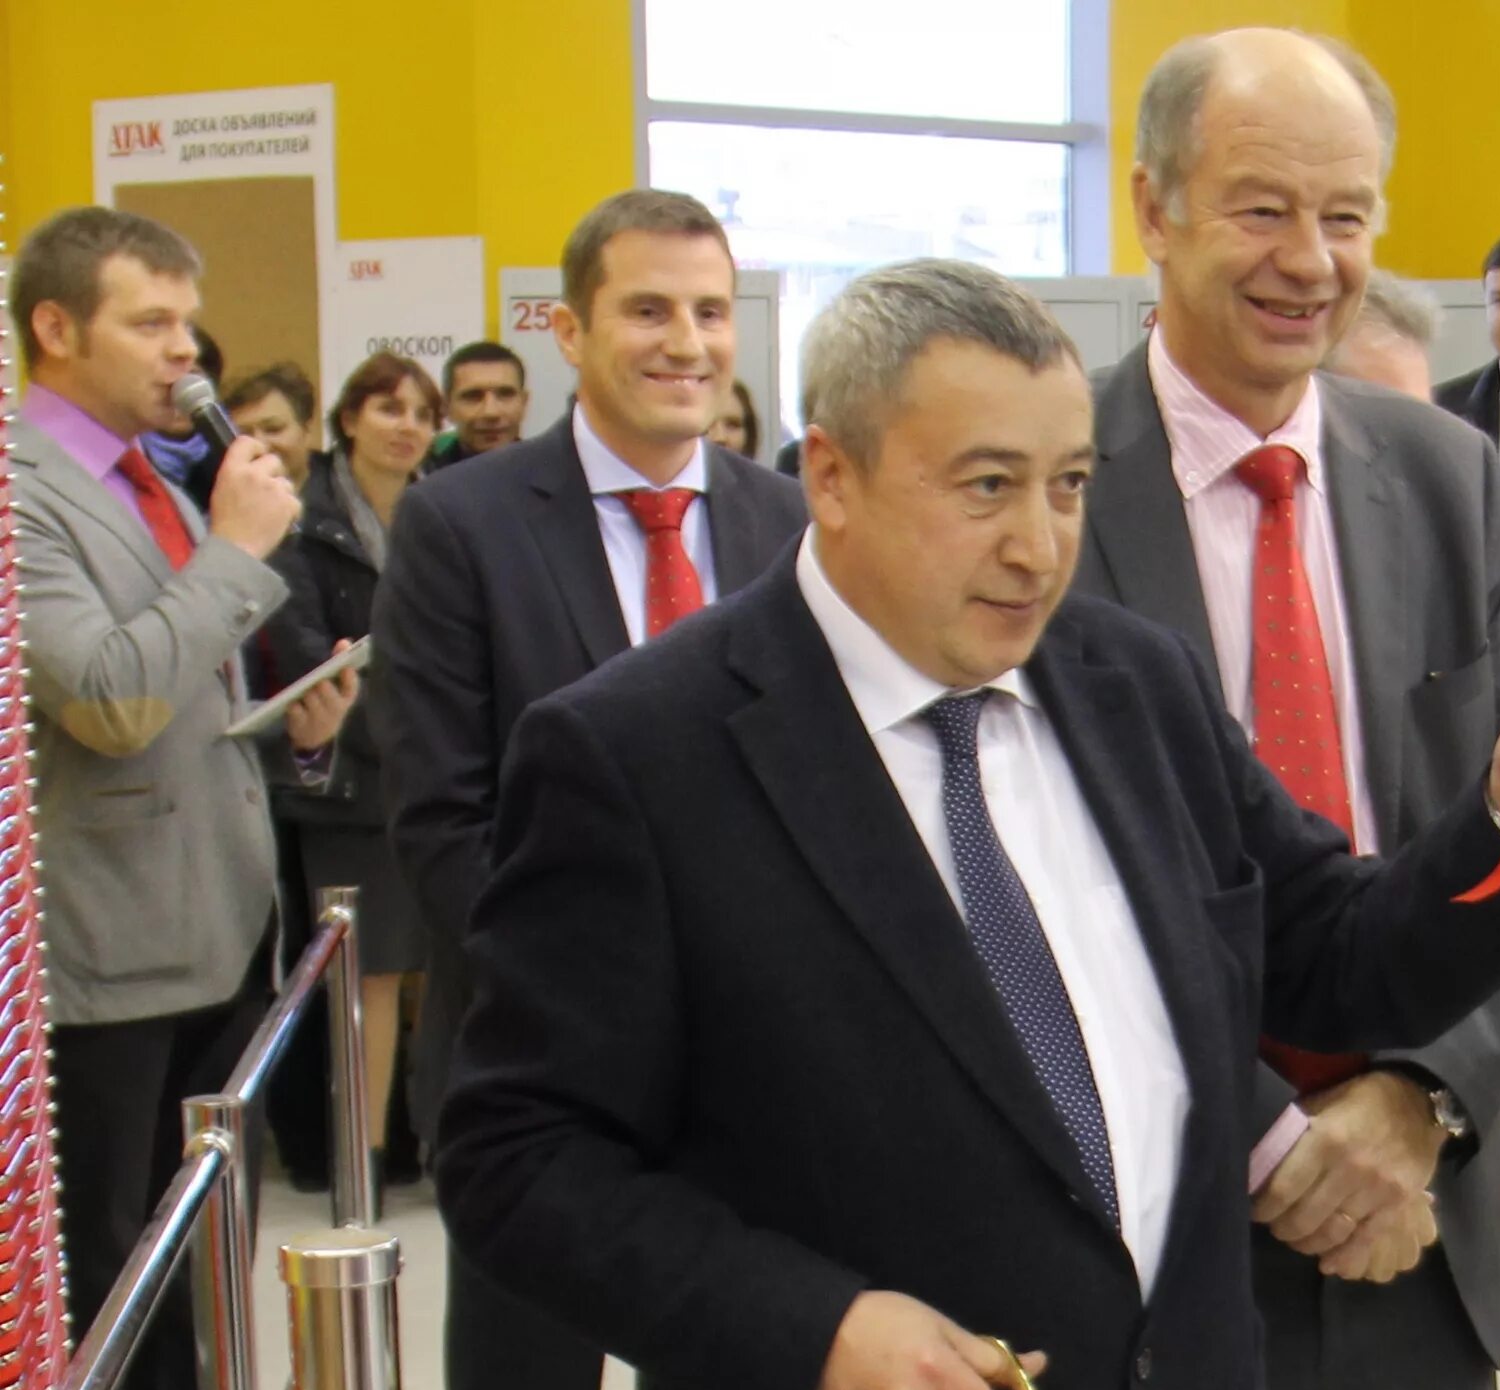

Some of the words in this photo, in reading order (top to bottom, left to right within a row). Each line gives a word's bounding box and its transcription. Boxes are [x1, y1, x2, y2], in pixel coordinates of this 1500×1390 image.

[172, 118, 216, 136] ДОСКА
[220, 108, 317, 132] ОБЪЯВЛЕНИЙ
[180, 144, 206, 162] ДЛЯ
[209, 136, 310, 159] ПОКУПАТЕЛЕЙ
[512, 301, 551, 331] 25
